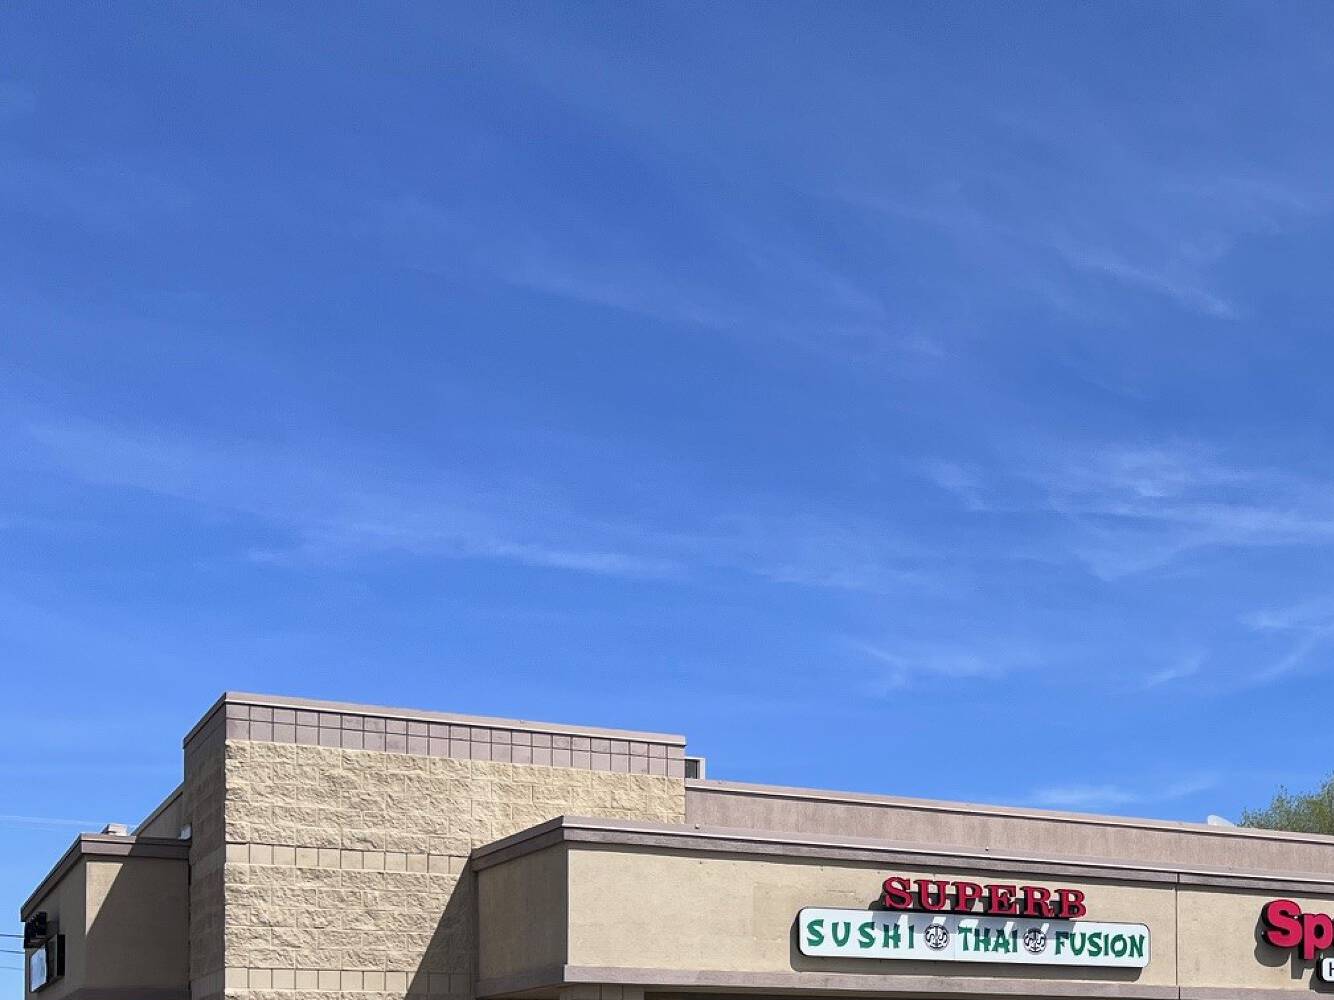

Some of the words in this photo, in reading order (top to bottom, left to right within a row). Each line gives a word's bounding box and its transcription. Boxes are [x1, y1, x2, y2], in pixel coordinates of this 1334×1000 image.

[881, 876, 1087, 919] SUPERB
[806, 917, 915, 950] SUSHI
[958, 925, 1019, 954] THAI
[1054, 929, 1145, 959] FUSION
